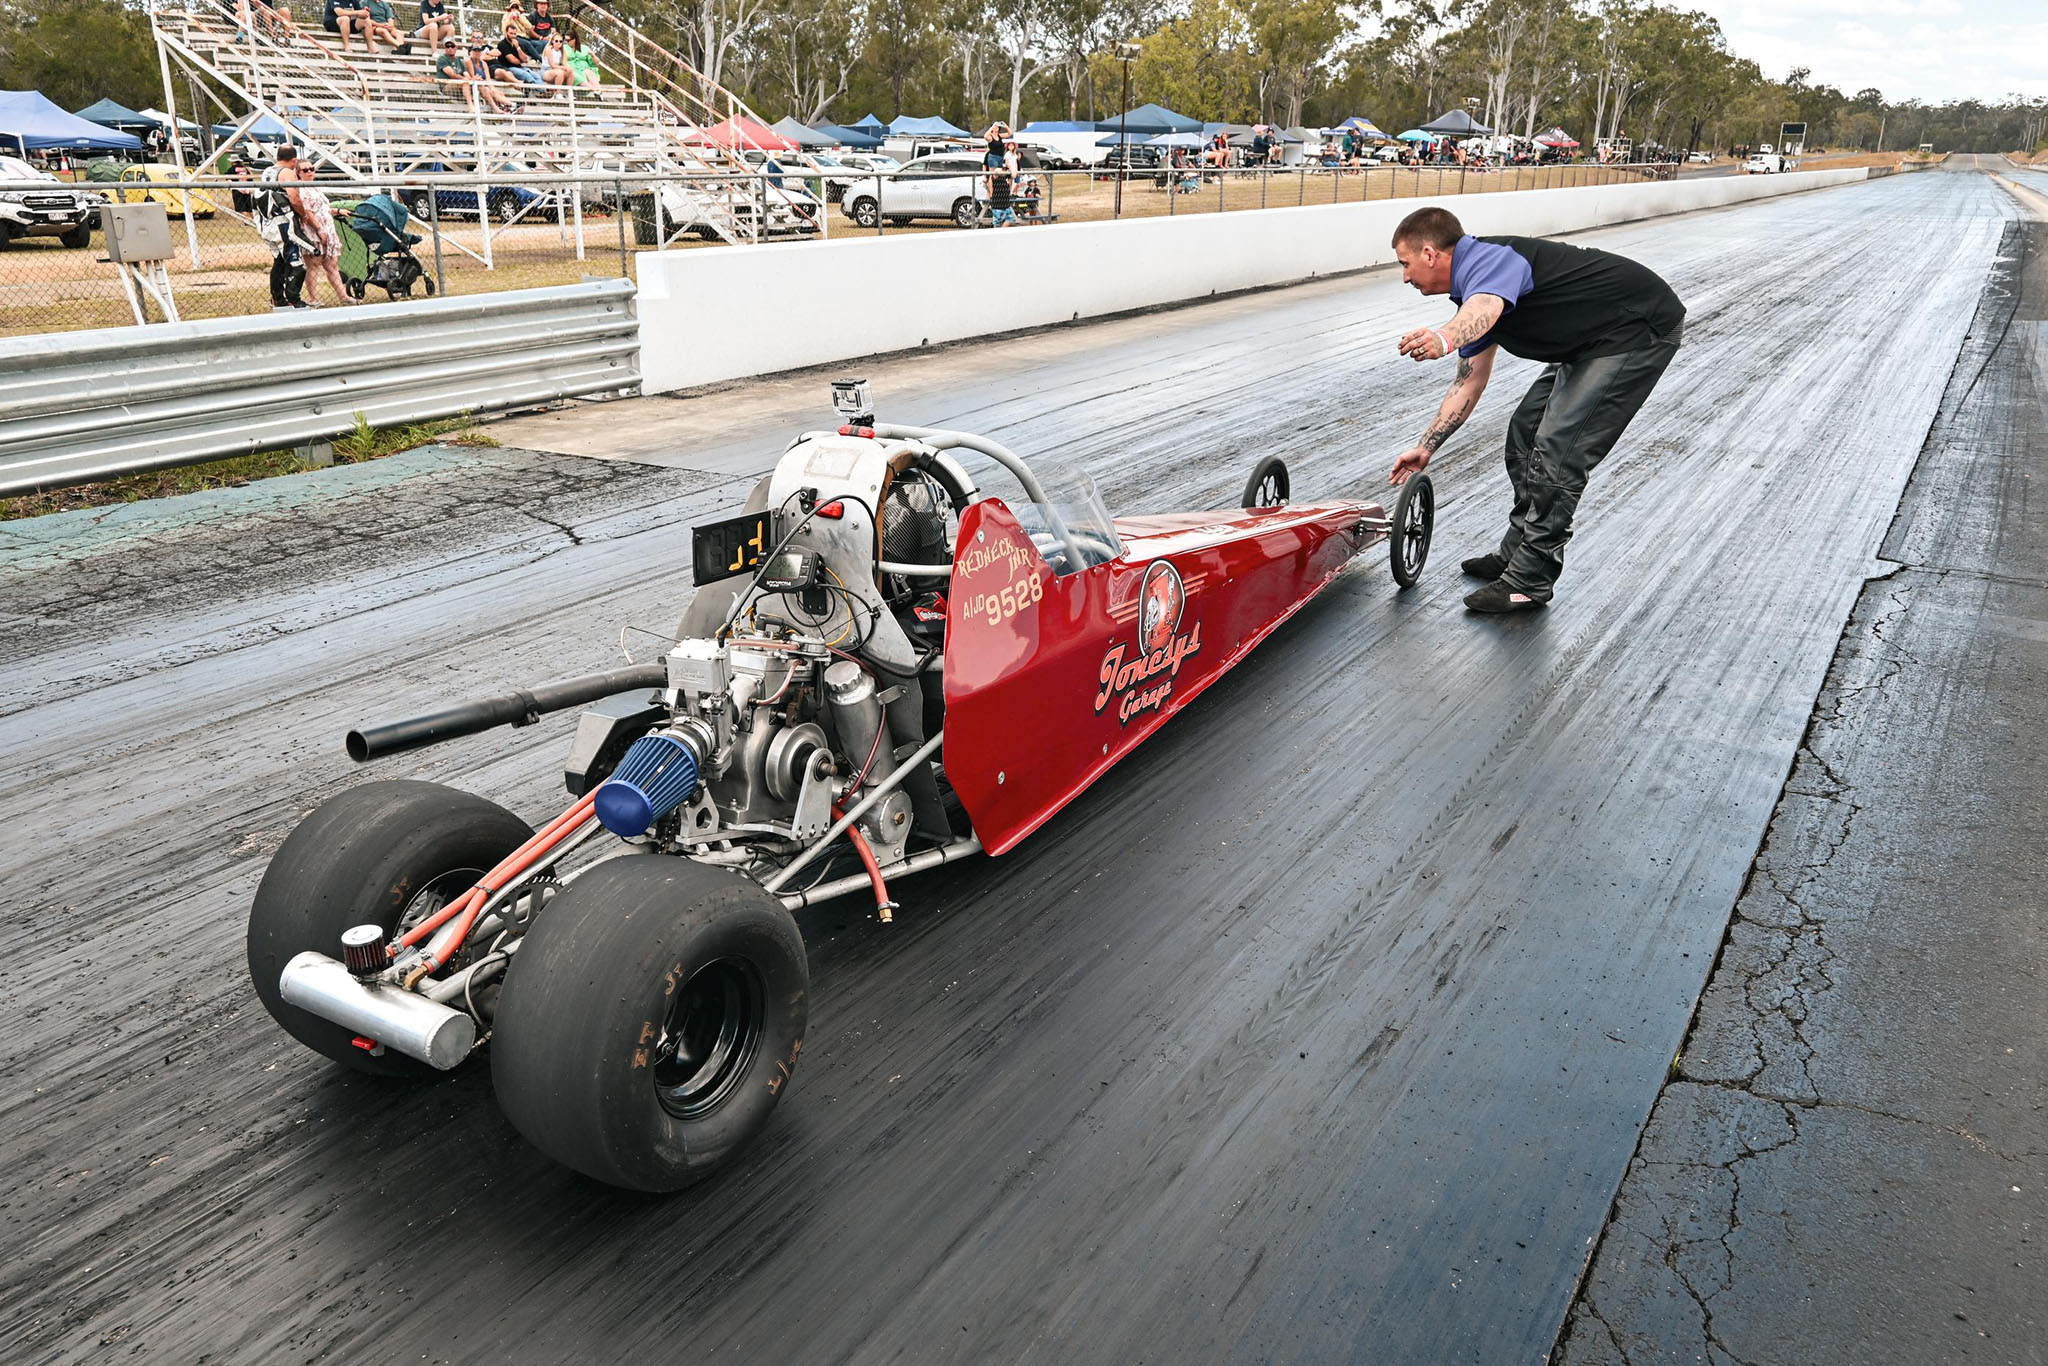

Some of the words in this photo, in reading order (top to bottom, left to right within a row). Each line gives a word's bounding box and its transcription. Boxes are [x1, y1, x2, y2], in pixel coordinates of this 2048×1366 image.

[957, 537, 1014, 579] REDNECK
[1008, 547, 1035, 584] JNR
[985, 572, 1043, 626] 9528
[1094, 620, 1201, 711] Jonesys
[1119, 680, 1172, 723] Garage
